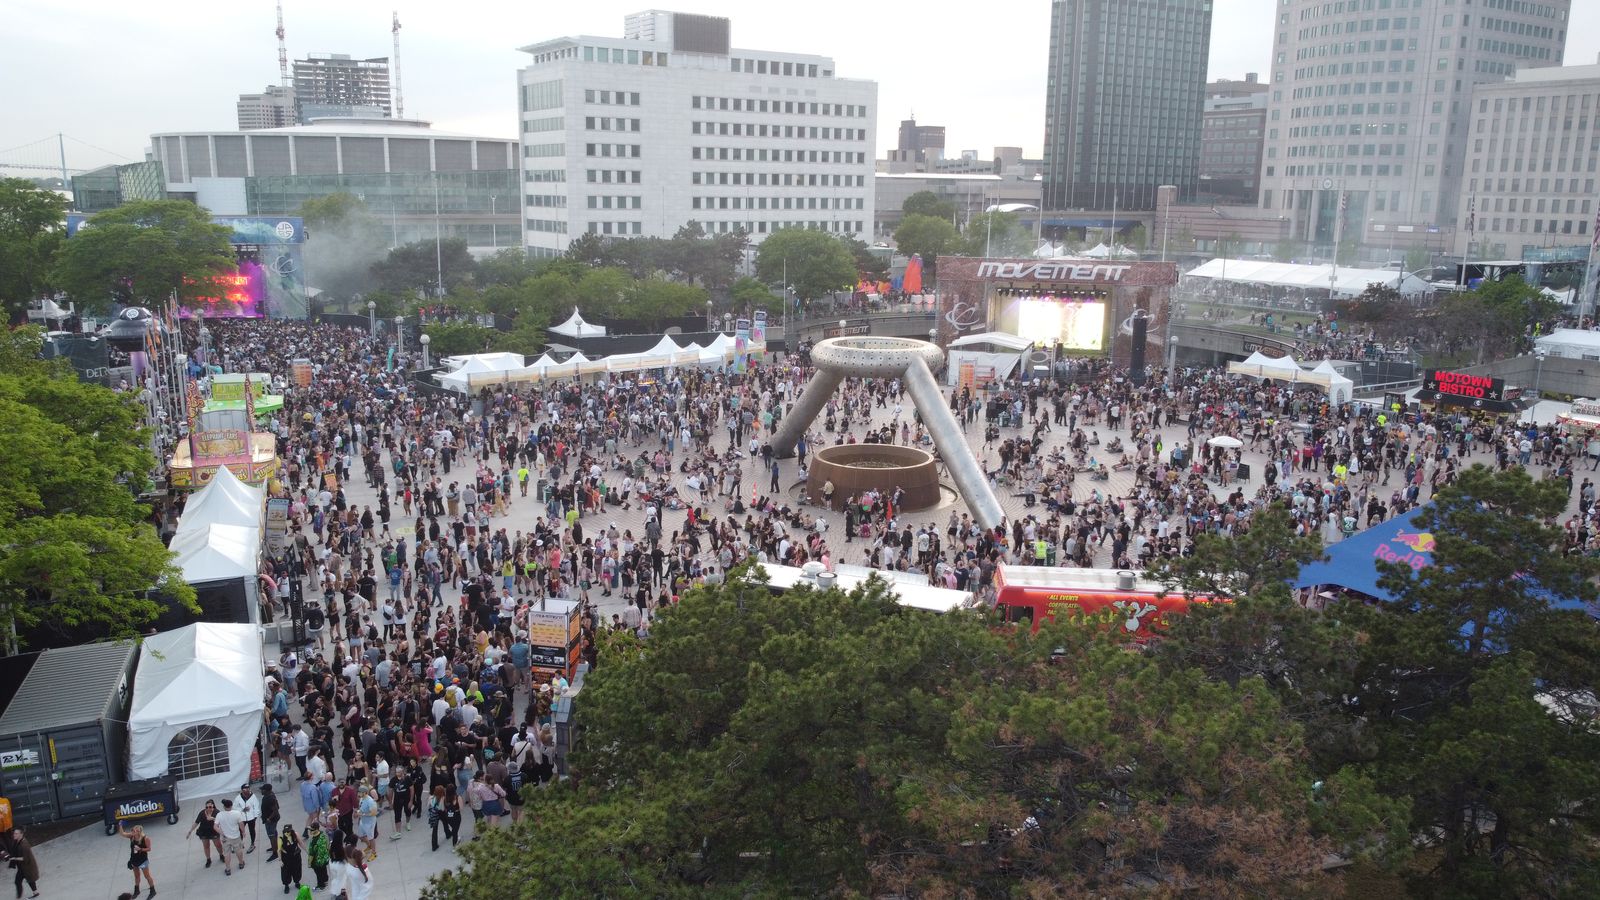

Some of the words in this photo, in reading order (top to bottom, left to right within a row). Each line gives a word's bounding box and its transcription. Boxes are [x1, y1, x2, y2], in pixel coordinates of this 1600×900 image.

[977, 262, 1131, 281] MOVEMENT
[1434, 371, 1493, 389] MOTOWN
[1439, 382, 1485, 398] BISTRO
[120, 801, 158, 815] Modelo
